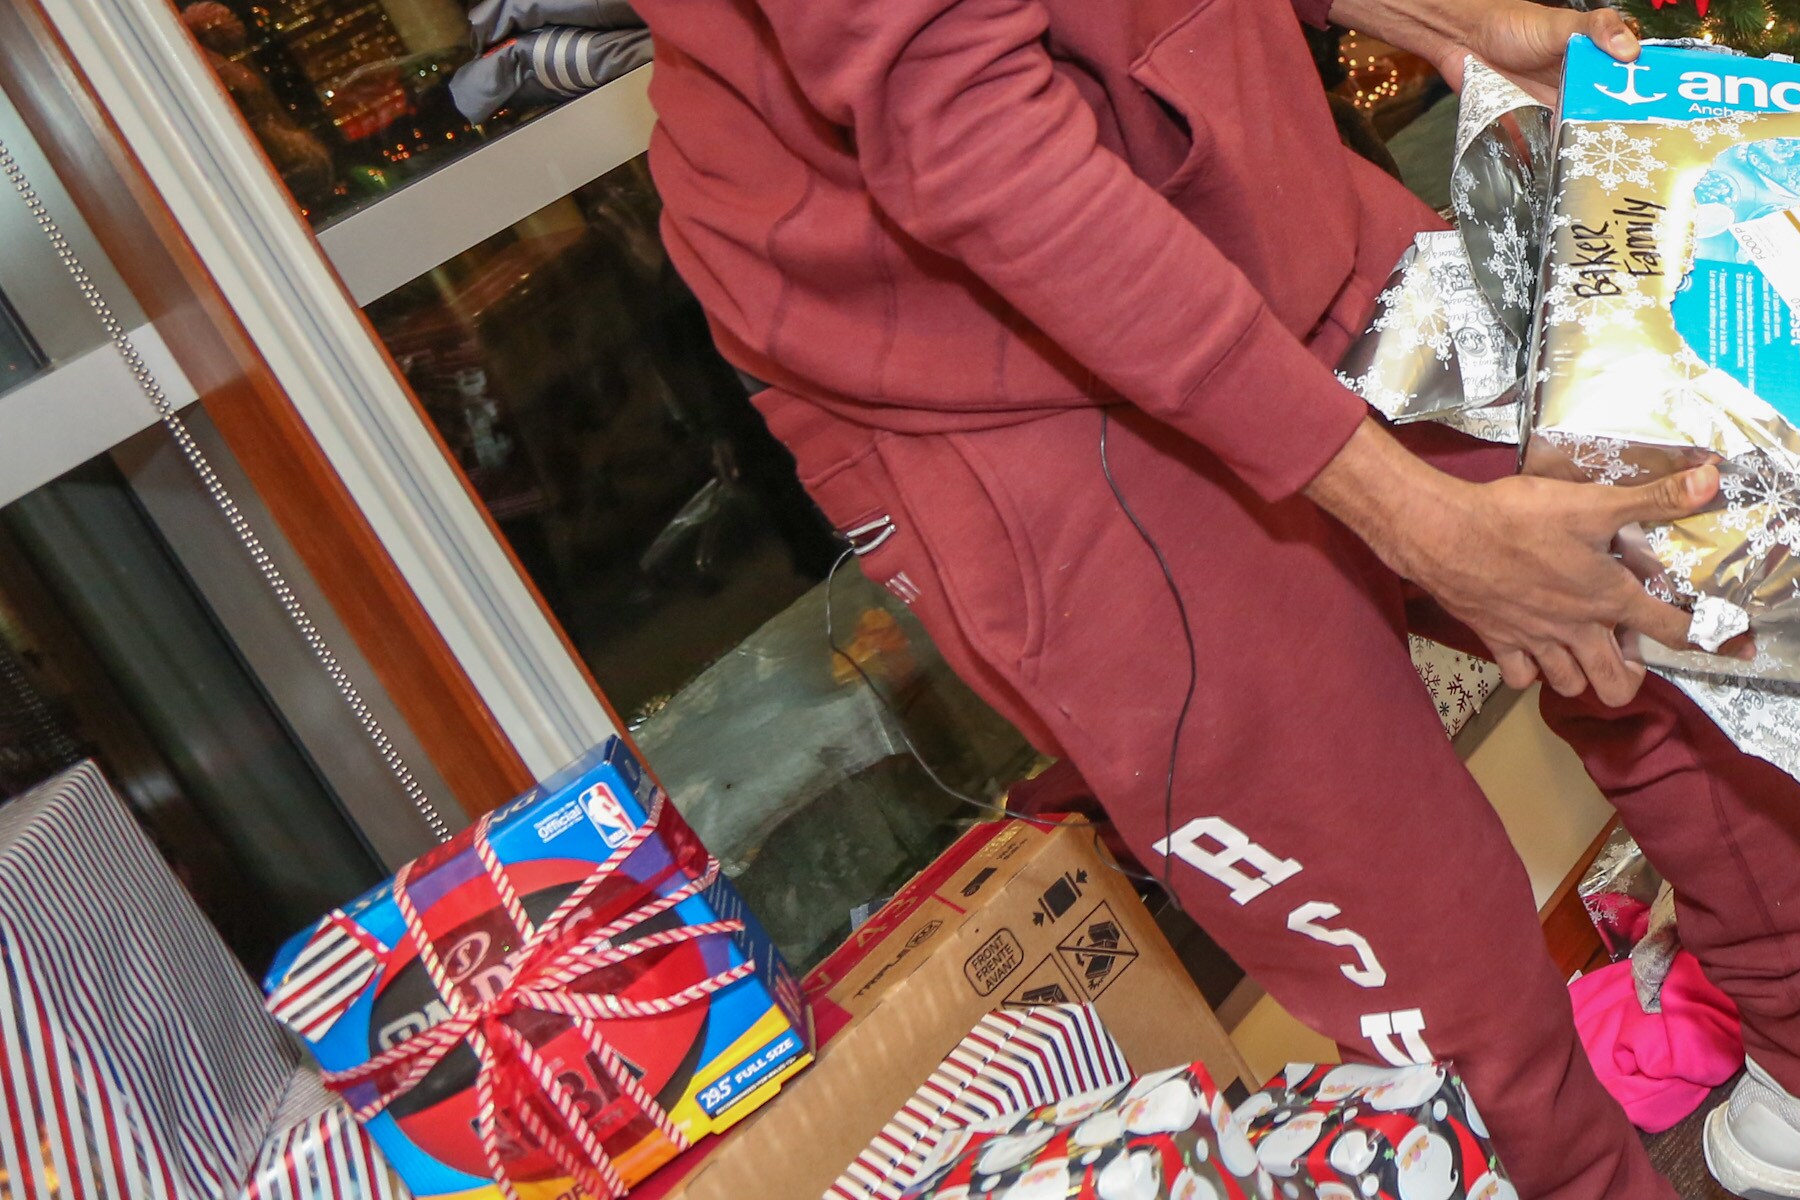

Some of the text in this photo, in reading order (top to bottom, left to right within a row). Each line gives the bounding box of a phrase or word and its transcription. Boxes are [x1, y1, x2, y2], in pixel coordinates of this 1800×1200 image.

[1612, 197, 1667, 277] Family
[536, 803, 583, 839] Official
[971, 934, 1005, 970] FRONT
[975, 943, 1013, 982] FRENTE
[985, 954, 1017, 990] AVANT
[734, 1057, 766, 1083] FULL
[765, 1037, 794, 1061] SIZE
